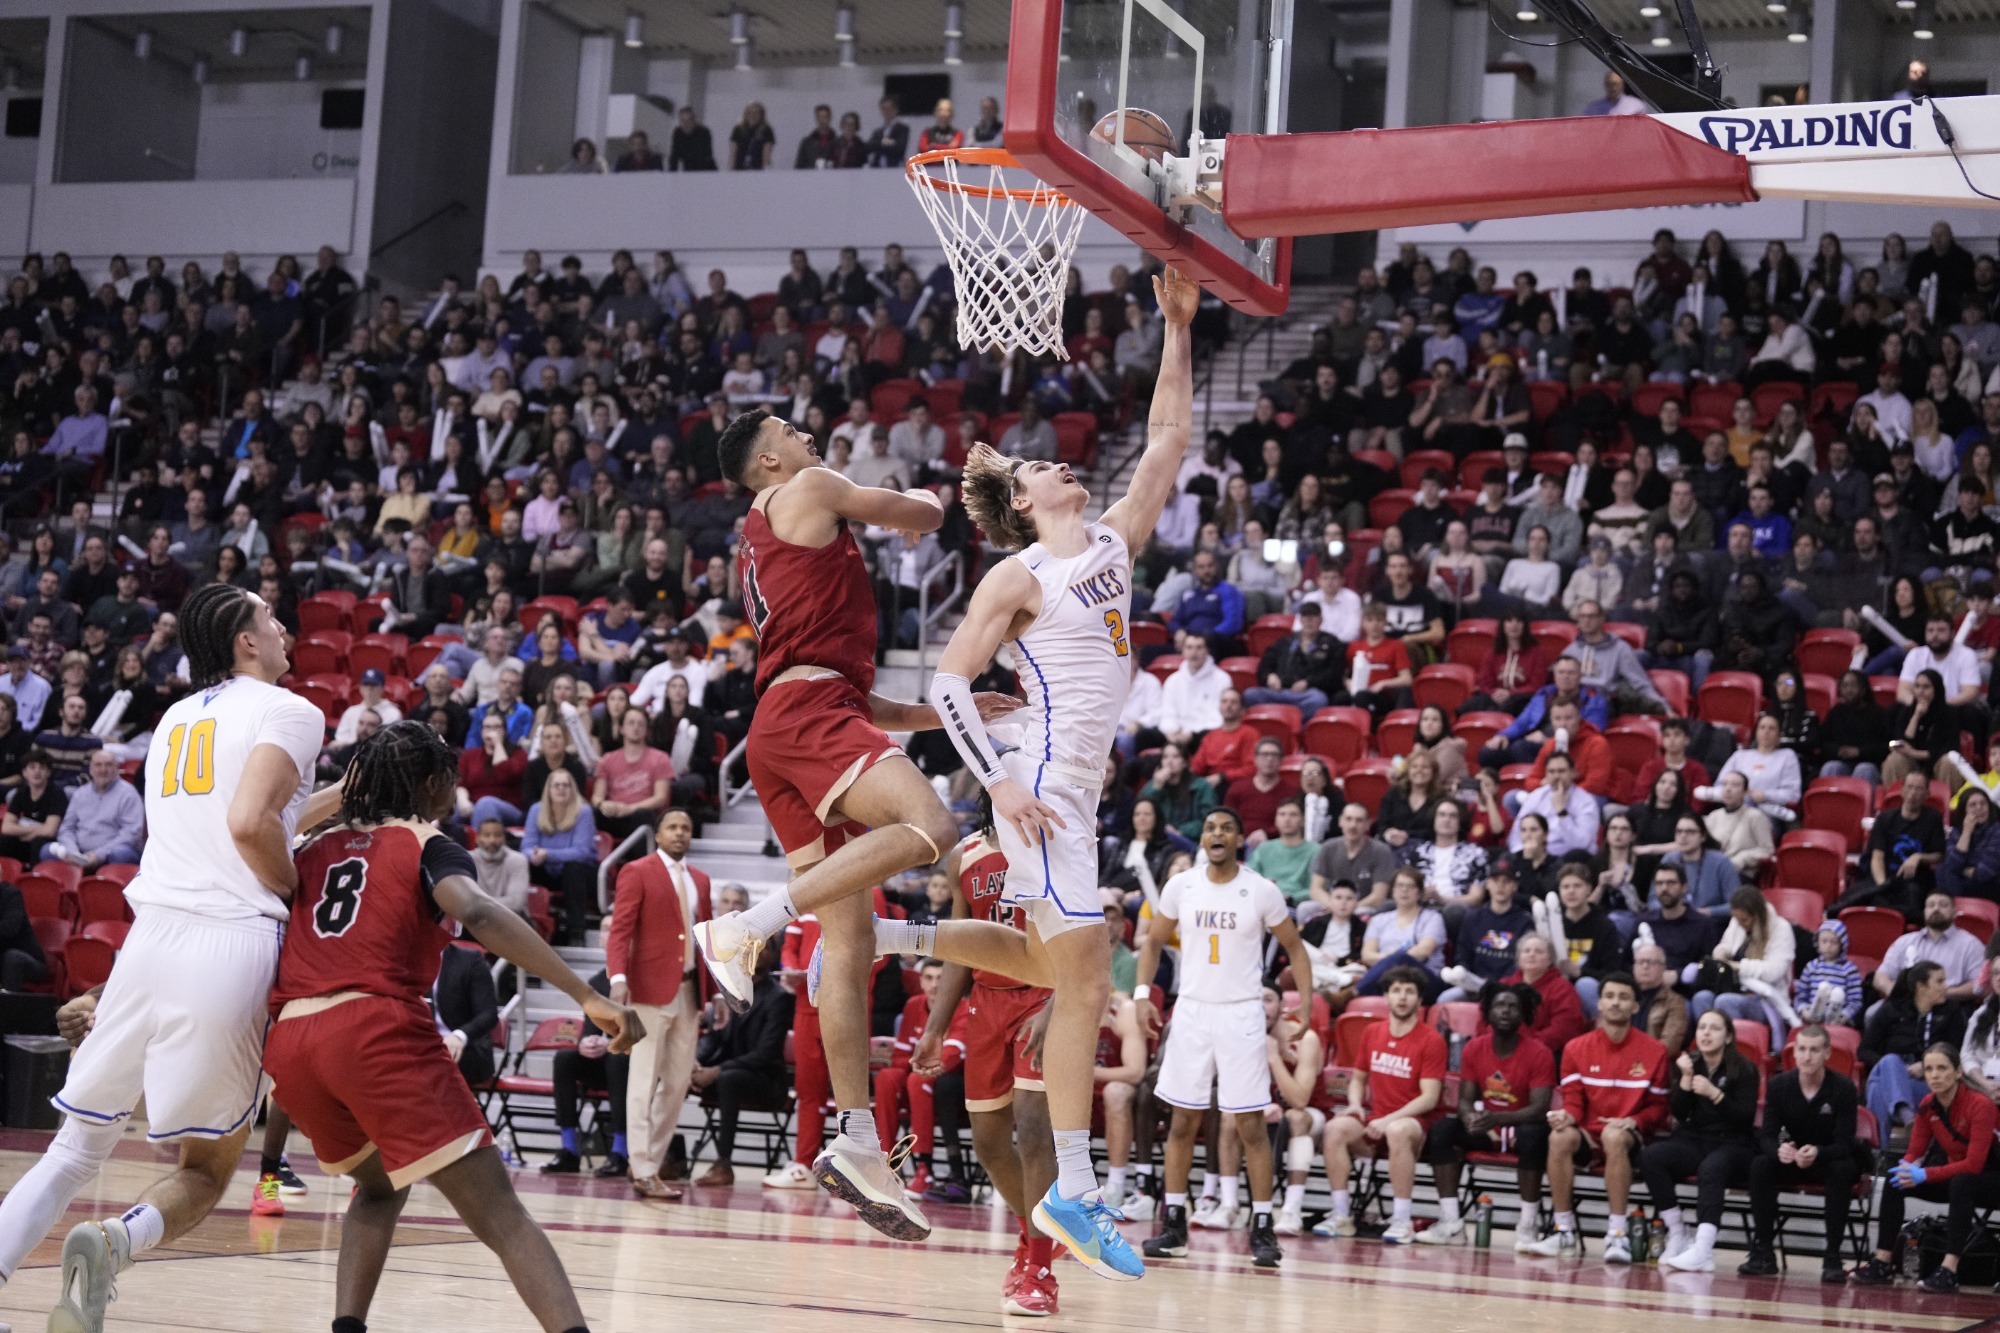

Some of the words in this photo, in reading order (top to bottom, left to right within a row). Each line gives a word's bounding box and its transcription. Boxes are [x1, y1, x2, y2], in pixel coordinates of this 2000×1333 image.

[1699, 104, 1912, 153] SPALDING
[1069, 568, 1125, 608] VIKES
[1103, 608, 1128, 657] 2
[161, 717, 217, 798] 10
[312, 856, 369, 938] 8
[1195, 910, 1236, 930] VIKES
[1209, 934, 1220, 965] 1
[1371, 1050, 1413, 1072] LAVAL
